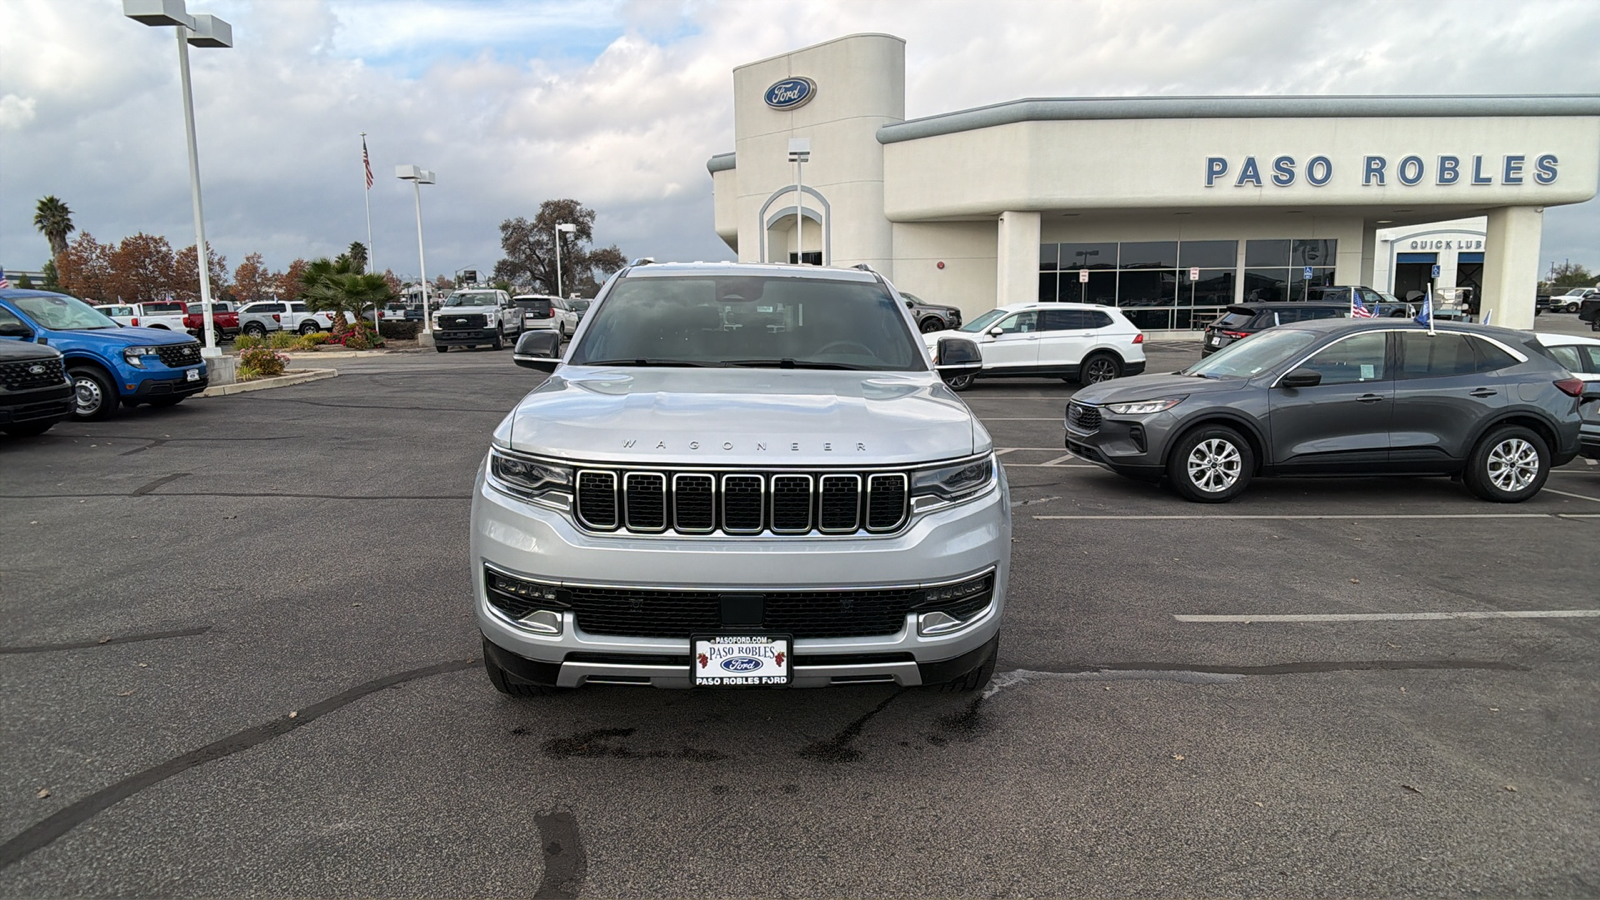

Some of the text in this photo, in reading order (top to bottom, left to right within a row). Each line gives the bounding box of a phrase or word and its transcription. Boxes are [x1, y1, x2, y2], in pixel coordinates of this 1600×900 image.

[771, 83, 801, 103] Ford
[1205, 154, 1560, 187] PASO ROBLES
[1410, 240, 1486, 250] QUICK LUB
[622, 439, 867, 452] WAGONEER
[715, 636, 768, 644] PASOFORD.COM
[709, 646, 776, 660] PASO ROBLES
[729, 659, 756, 670] Ford
[696, 676, 787, 685] PASO ROBLES FORD
